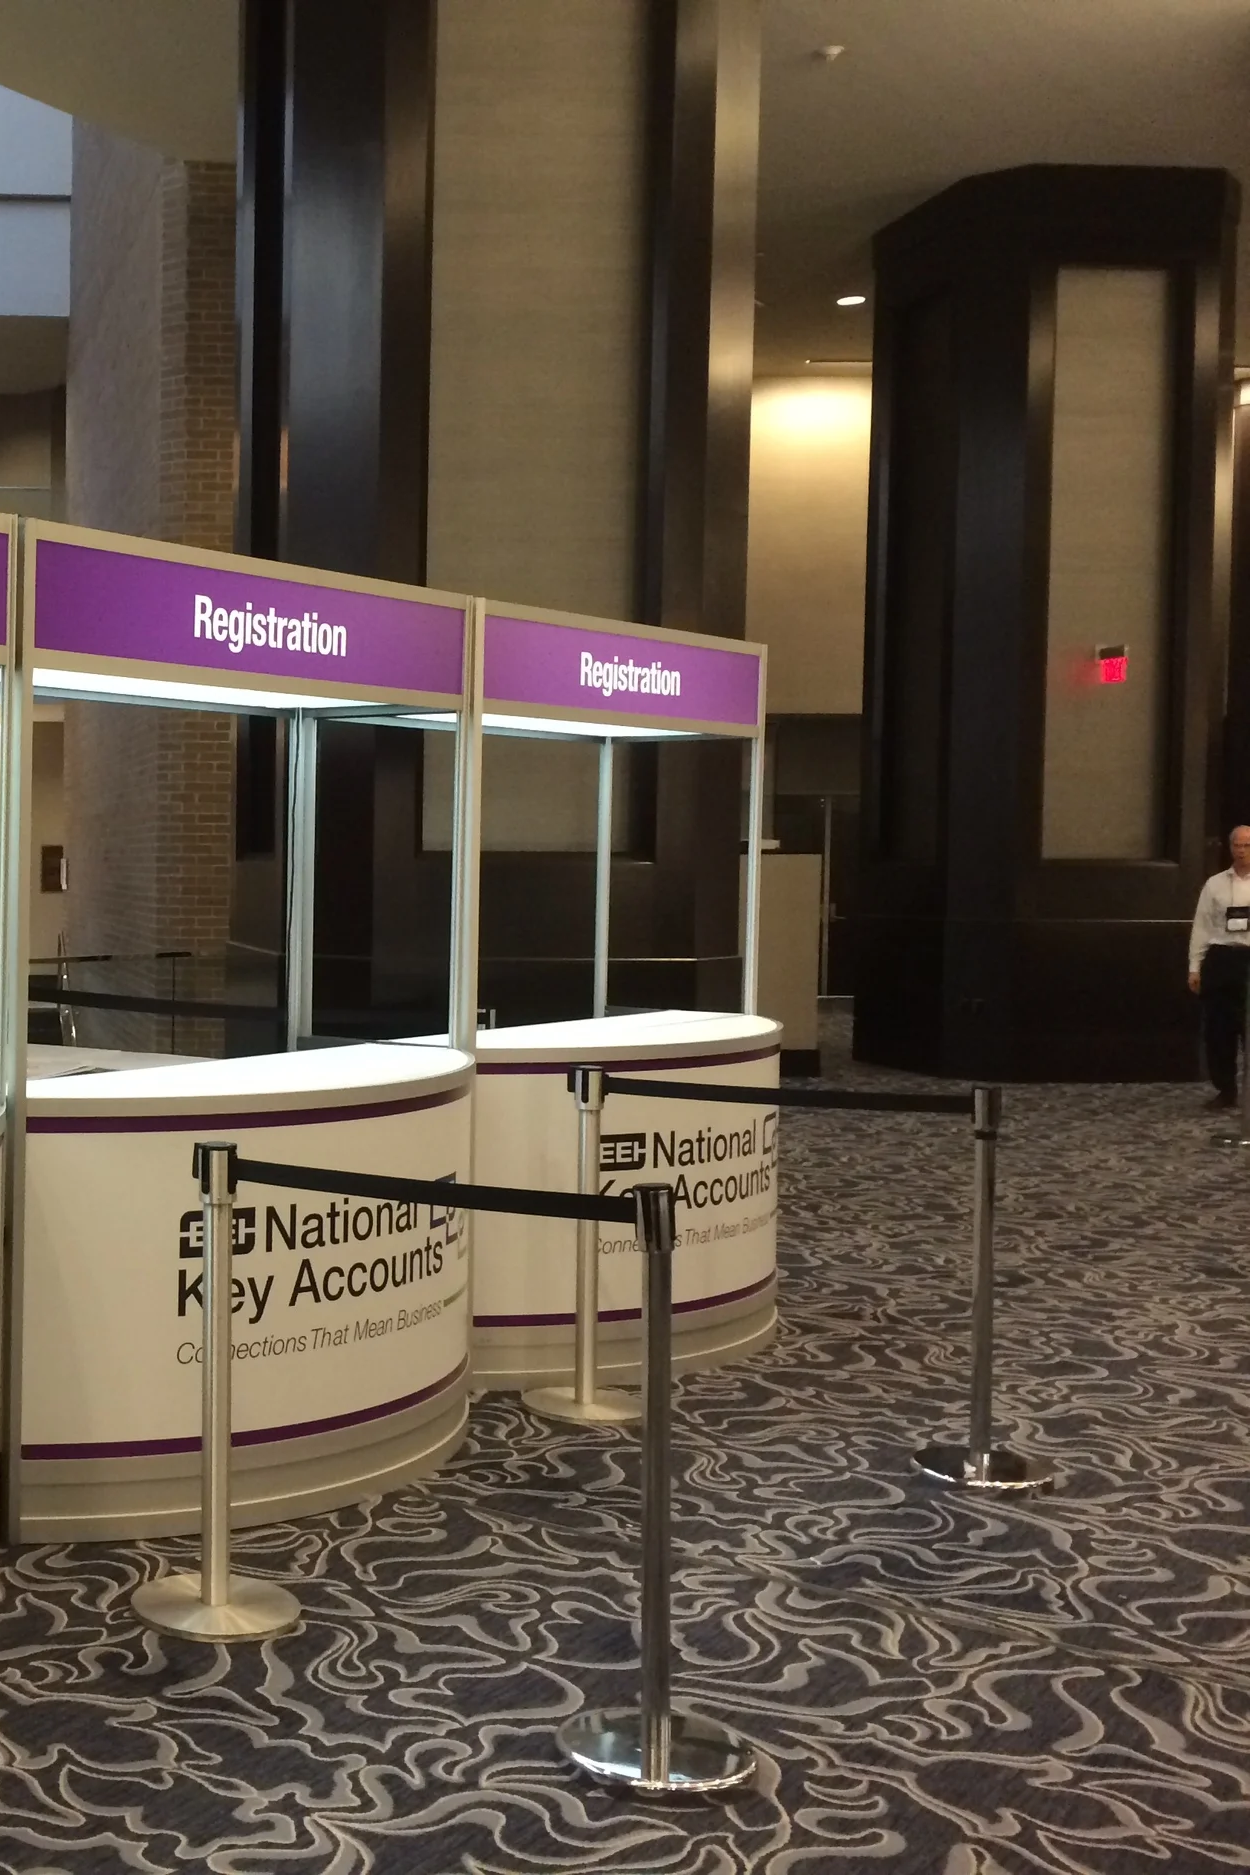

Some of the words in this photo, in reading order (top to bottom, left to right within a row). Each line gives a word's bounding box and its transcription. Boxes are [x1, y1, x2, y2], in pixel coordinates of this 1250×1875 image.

[193, 594, 347, 657] Registration
[580, 651, 681, 697] Registration
[652, 1118, 757, 1169] National
[673, 1160, 772, 1210] Accounts
[179, 1206, 256, 1259] EI
[265, 1196, 418, 1253] National
[685, 1226, 711, 1246] That
[288, 1236, 444, 1308] Accounts
[176, 1334, 308, 1365] Cections
[310, 1323, 350, 1350] That
[353, 1317, 393, 1342] Mean
[396, 1299, 443, 1331] Business
